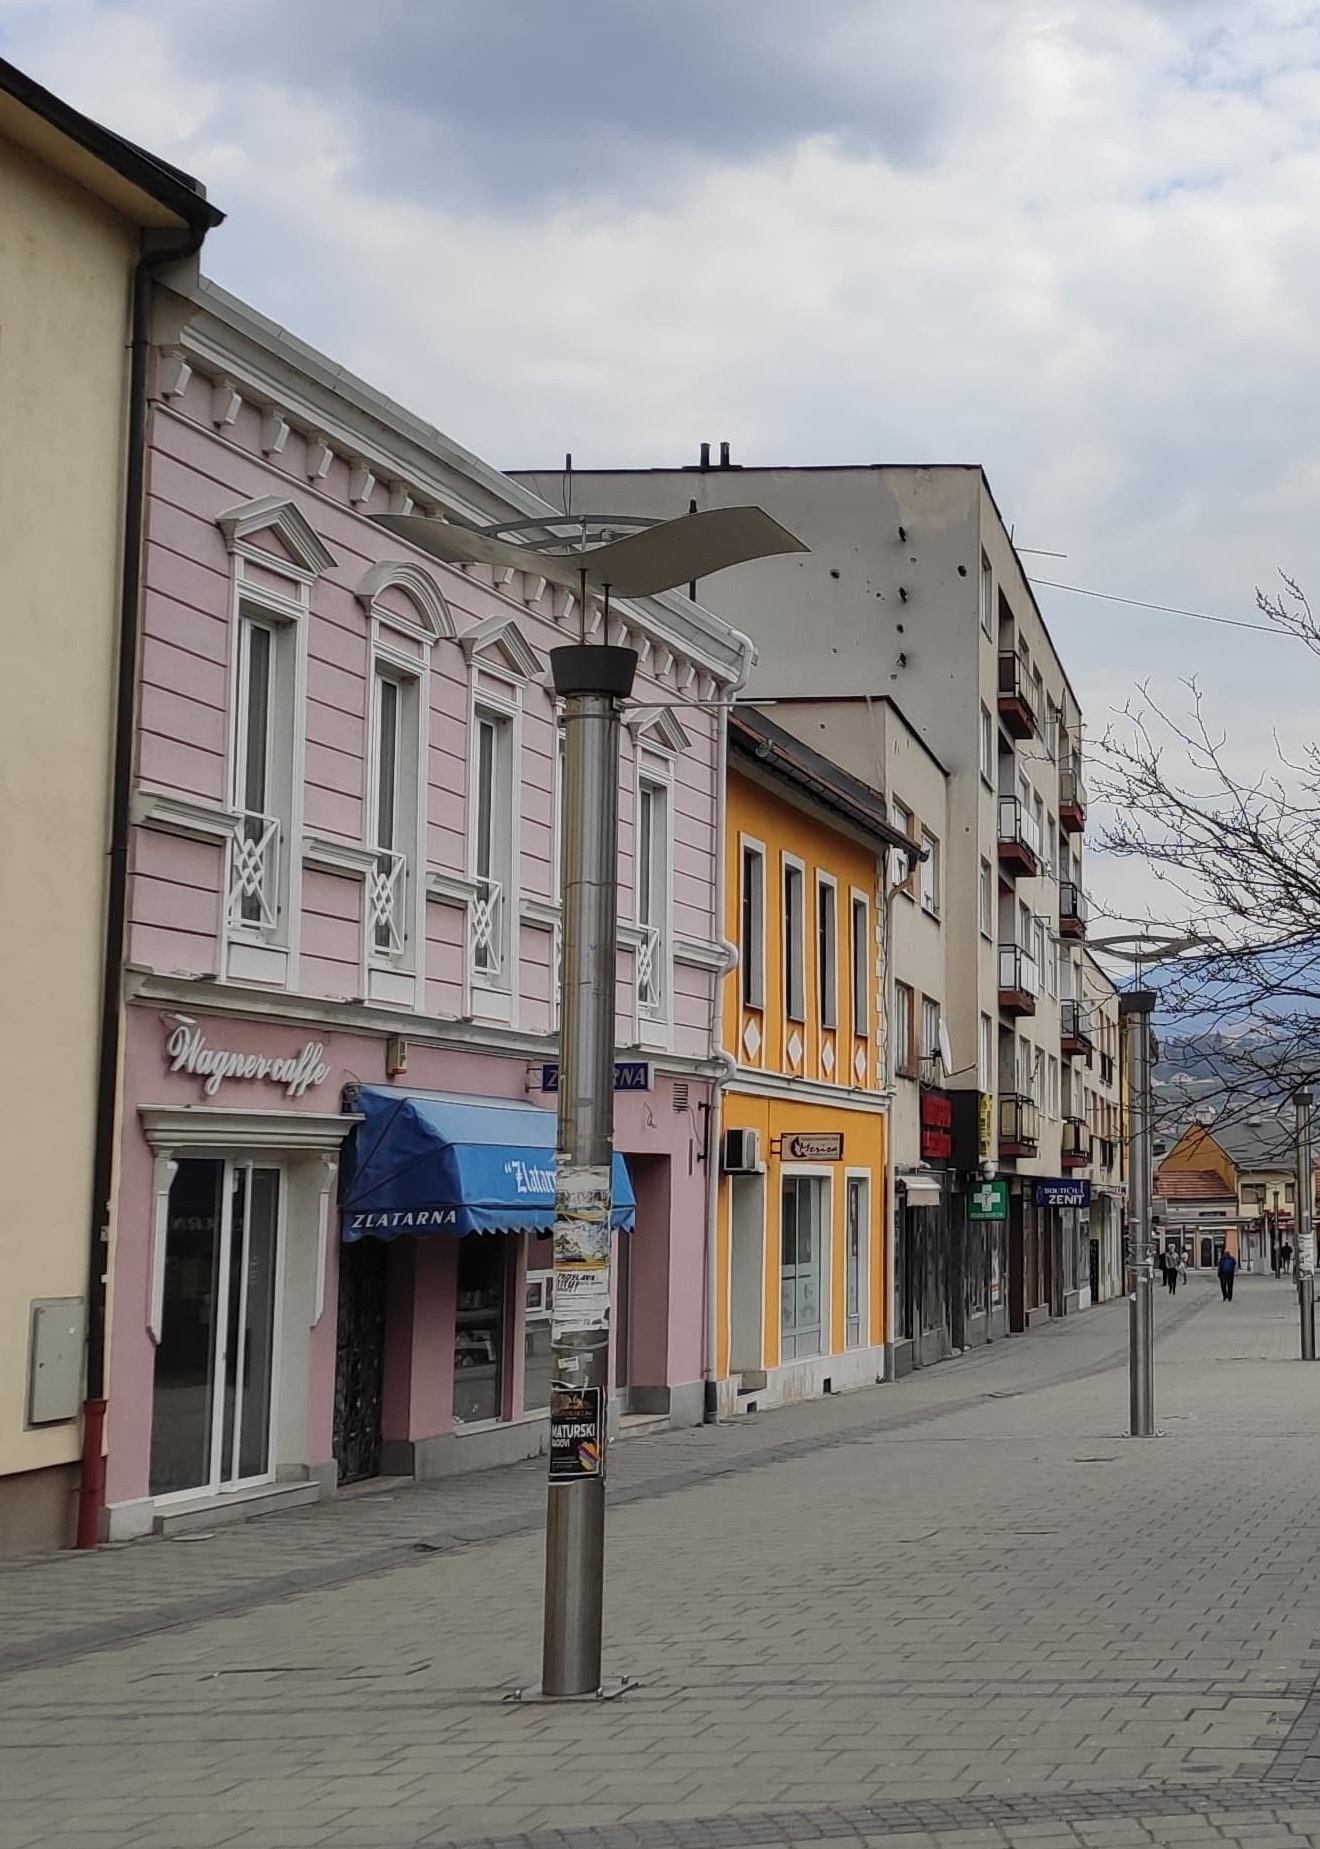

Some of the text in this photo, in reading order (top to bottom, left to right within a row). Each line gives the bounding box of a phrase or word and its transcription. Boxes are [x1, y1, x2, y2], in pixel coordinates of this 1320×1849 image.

[270, 1041, 331, 1097] caffe
[1048, 1194, 1084, 1205] ZENIT
[351, 1209, 457, 1228] ZLATARNA
[551, 1423, 596, 1439] MATURSKI
